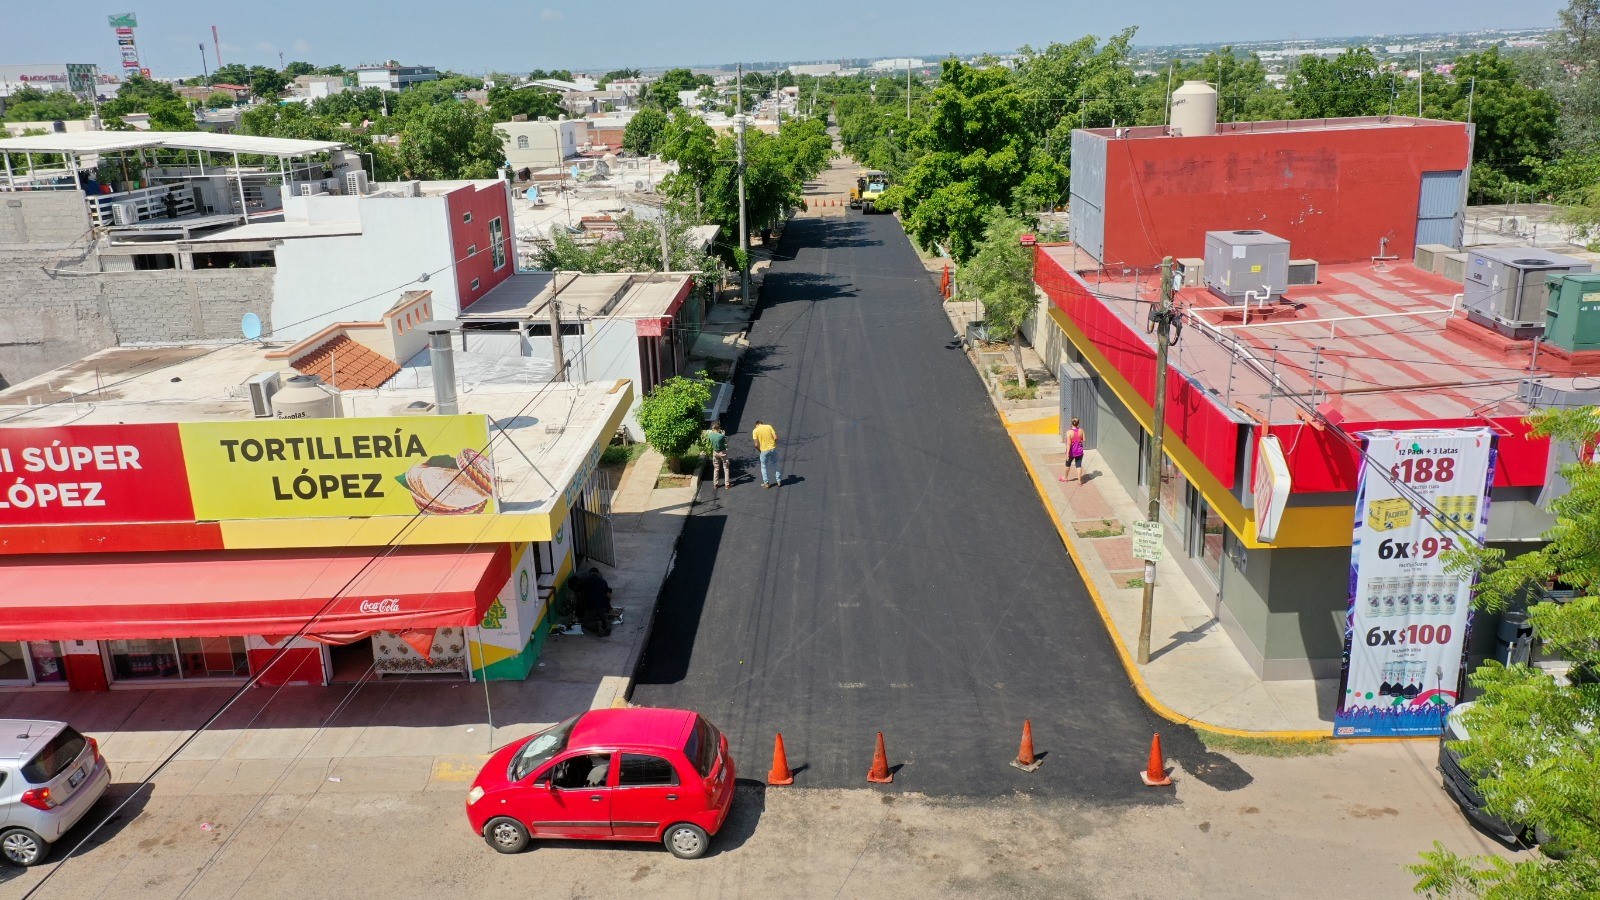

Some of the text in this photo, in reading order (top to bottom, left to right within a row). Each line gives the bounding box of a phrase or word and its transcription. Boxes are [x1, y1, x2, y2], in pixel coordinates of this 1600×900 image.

[22, 440, 142, 472] SÚPER
[220, 428, 427, 462] TORTILLERÍA
[272, 468, 384, 500] LÓPEZ
[1390, 458, 1455, 484] $188
[360, 598, 400, 613] Coca-Cola
